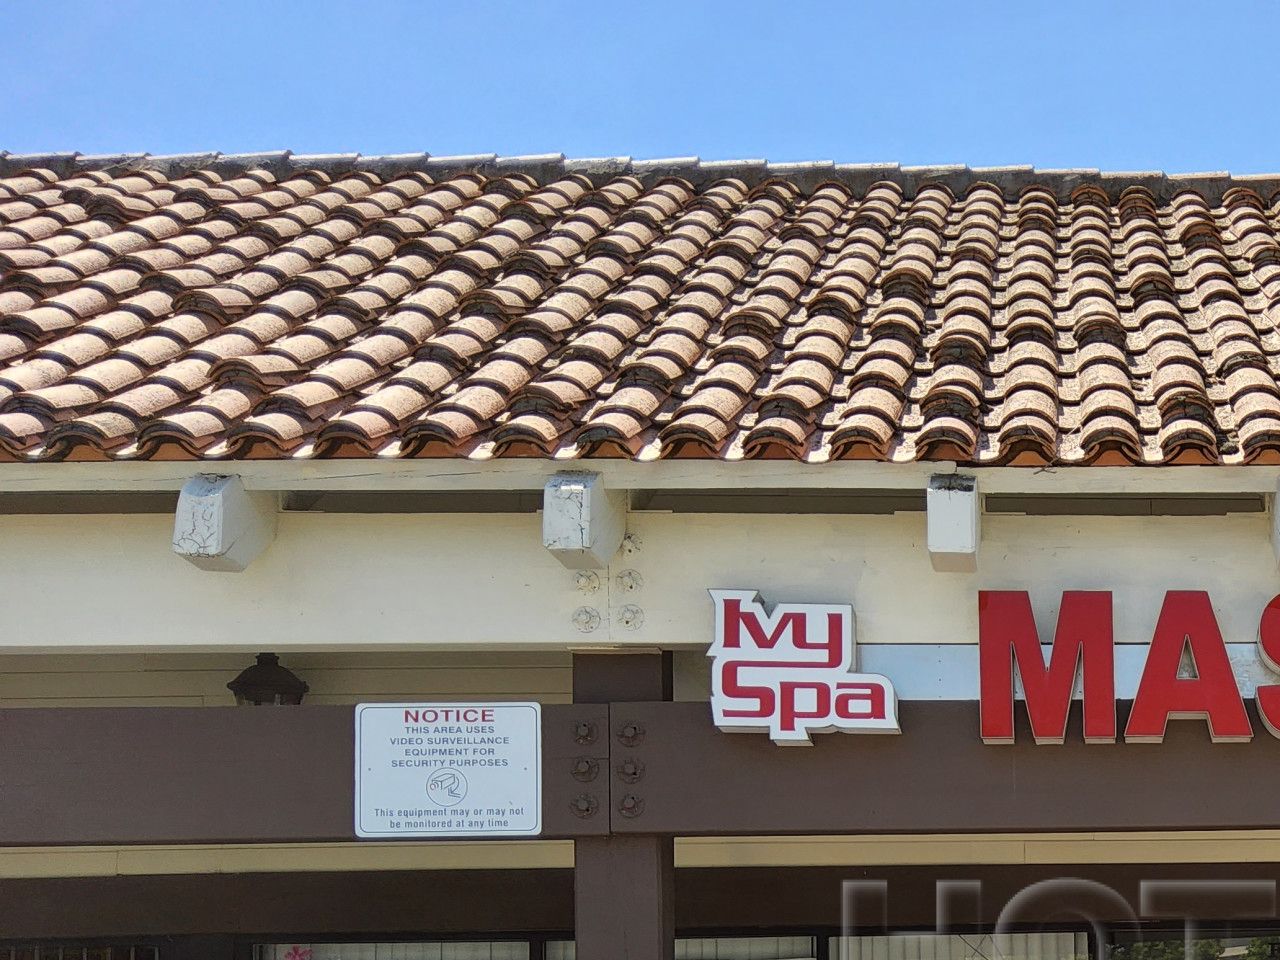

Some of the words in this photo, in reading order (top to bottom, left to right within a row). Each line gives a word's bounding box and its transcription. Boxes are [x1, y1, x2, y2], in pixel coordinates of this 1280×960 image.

[721, 660, 886, 731] Spa
[404, 709, 495, 723] NOTICE
[405, 726, 430, 734] THIS
[433, 726, 463, 734] AREA
[466, 725, 495, 734] USES
[390, 737, 424, 746] VIDEO
[427, 736, 510, 745] SURVEILLANCE
[405, 748, 470, 757] EQUIPMENT
[473, 748, 495, 756] FOR
[391, 760, 446, 768] SECURITY
[450, 758, 508, 767] PURPOSES
[375, 808, 394, 818] This
[397, 808, 447, 818] equipment
[450, 809, 470, 818] may
[486, 808, 506, 818] may
[509, 807, 524, 815] not
[390, 820, 401, 829] be
[404, 819, 451, 828] monitored
[456, 818, 464, 828] at
[468, 819, 484, 829] any
[487, 819, 509, 828] time
